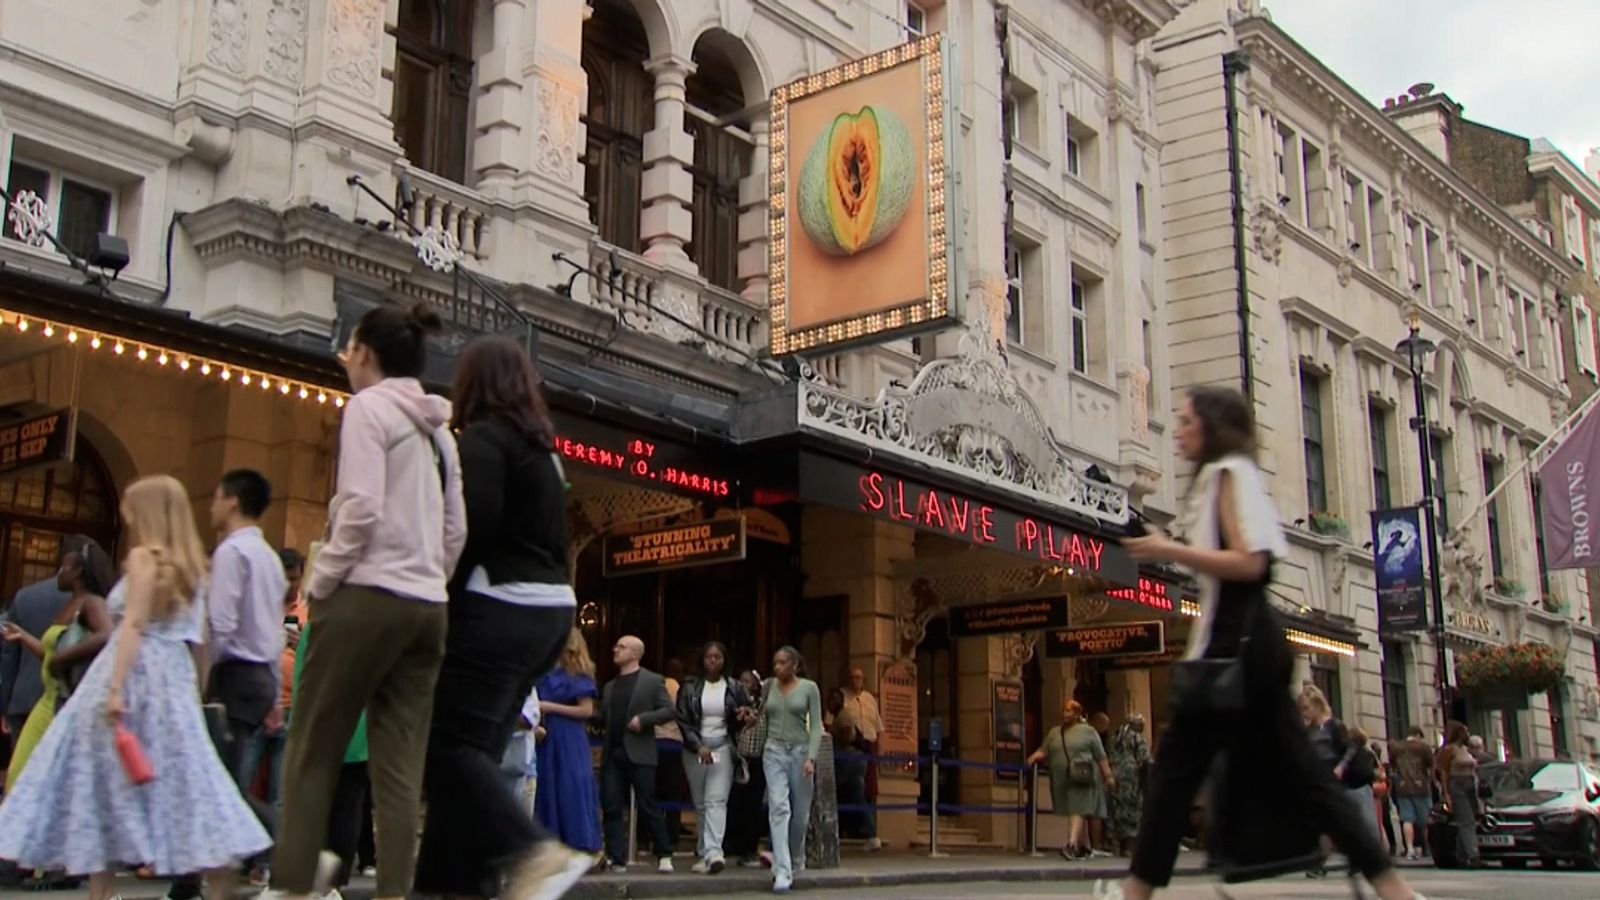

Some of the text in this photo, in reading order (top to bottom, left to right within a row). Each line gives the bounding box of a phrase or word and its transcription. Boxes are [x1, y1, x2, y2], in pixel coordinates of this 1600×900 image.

[21, 415, 58, 439] ONLY
[20, 437, 47, 459] SEP
[634, 440, 655, 457] BY
[666, 467, 729, 496] HARRIS
[863, 472, 1104, 570] SLAVE PLAY
[1566, 460, 1592, 560] BROWNS
